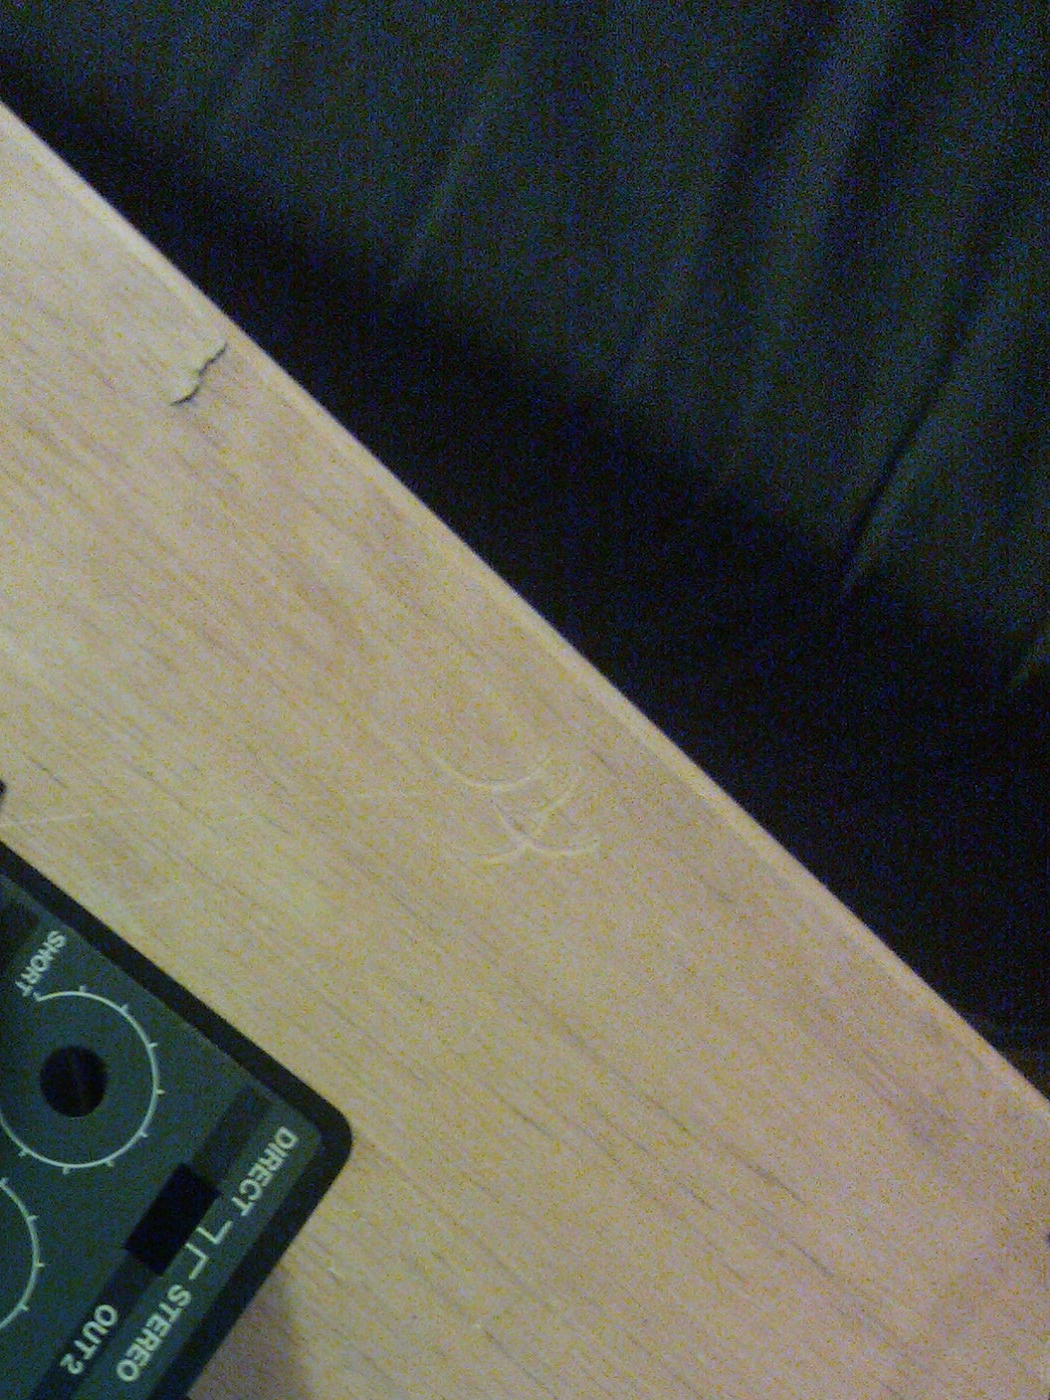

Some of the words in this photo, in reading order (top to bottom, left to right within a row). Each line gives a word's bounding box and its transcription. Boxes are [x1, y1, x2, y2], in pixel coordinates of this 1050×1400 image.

[14, 931, 65, 997] SHORT
[232, 1126, 298, 1217] DIRECT
[116, 1284, 191, 1382] STEREO
